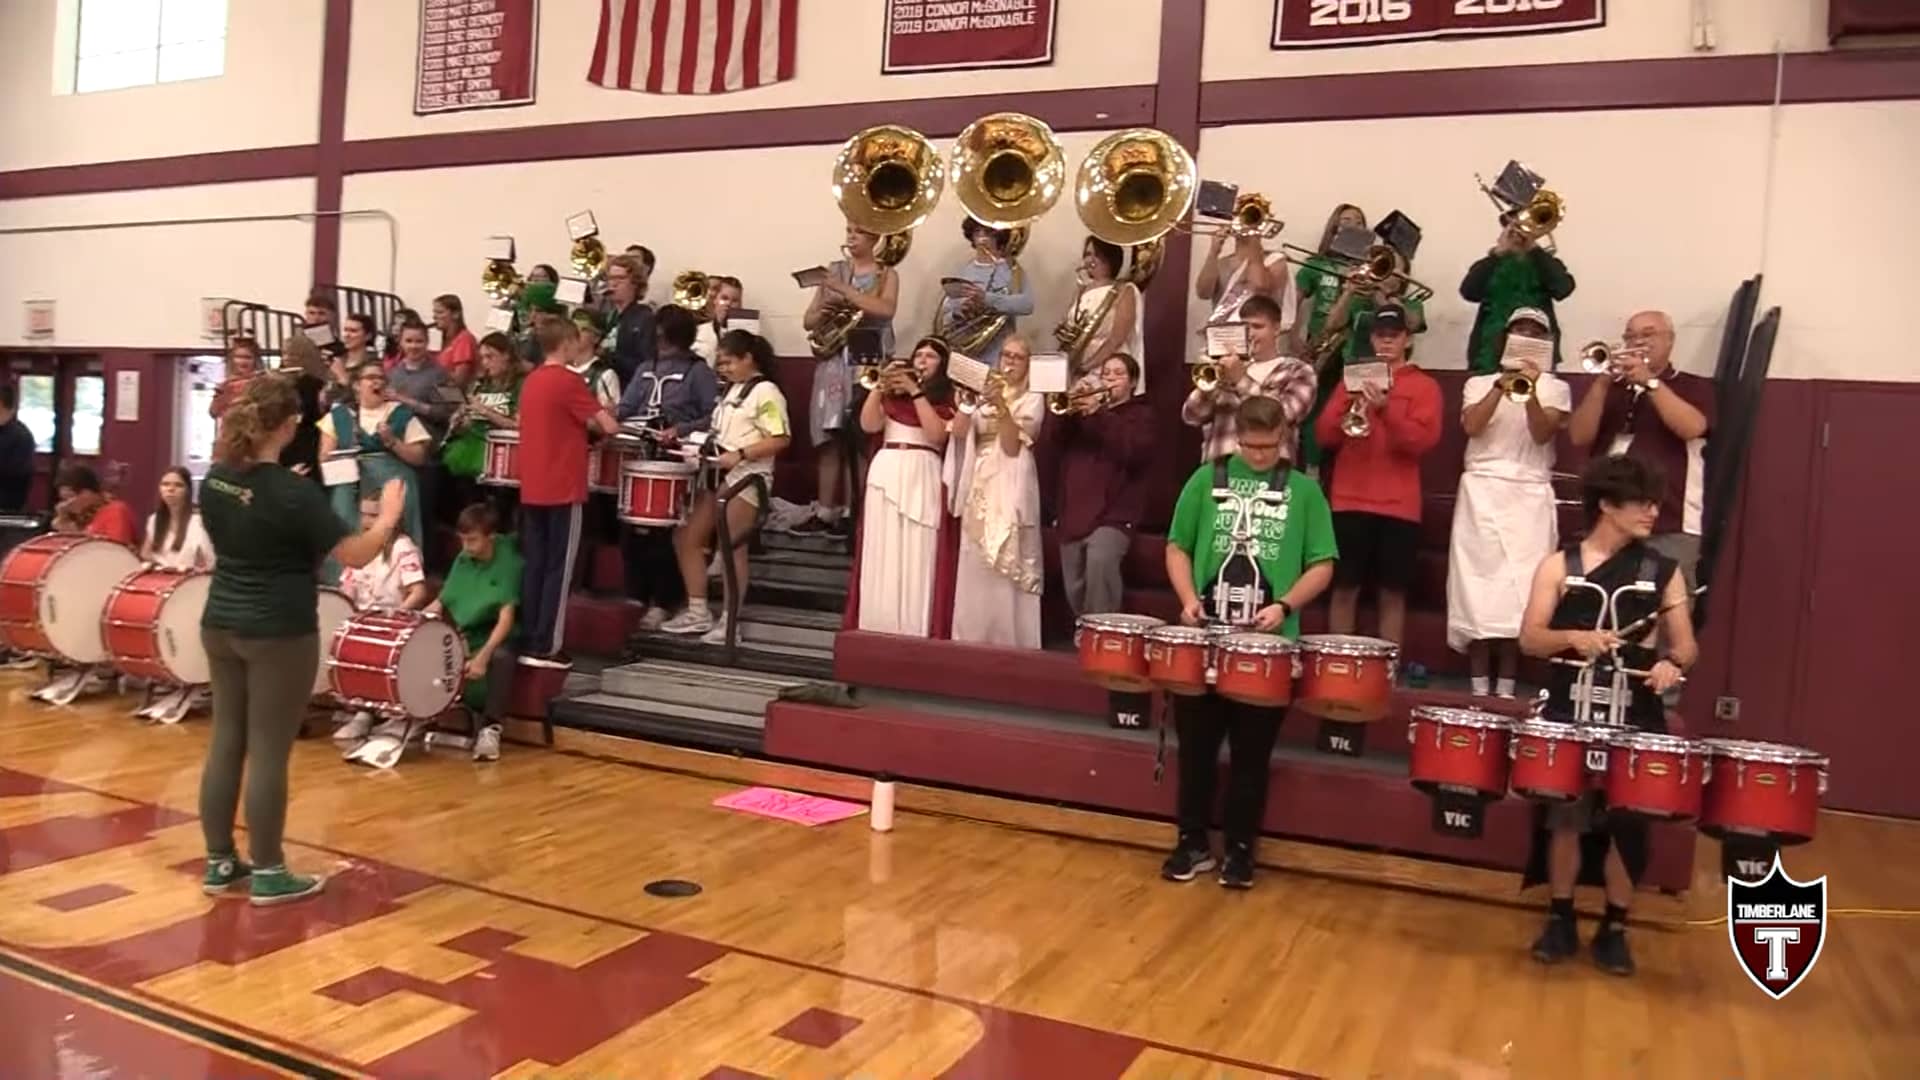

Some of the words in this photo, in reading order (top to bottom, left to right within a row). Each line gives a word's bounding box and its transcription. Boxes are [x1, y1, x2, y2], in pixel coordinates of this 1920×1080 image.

[894, 5, 923, 18] 2018
[925, 1, 970, 17] CONNOR
[1310, 0, 1411, 25] 2016
[893, 20, 922, 34] 2019
[924, 16, 968, 32] CONNOR
[1117, 712, 1140, 726] VIC
[1443, 810, 1472, 828] VIC
[1735, 859, 1769, 876] VIC
